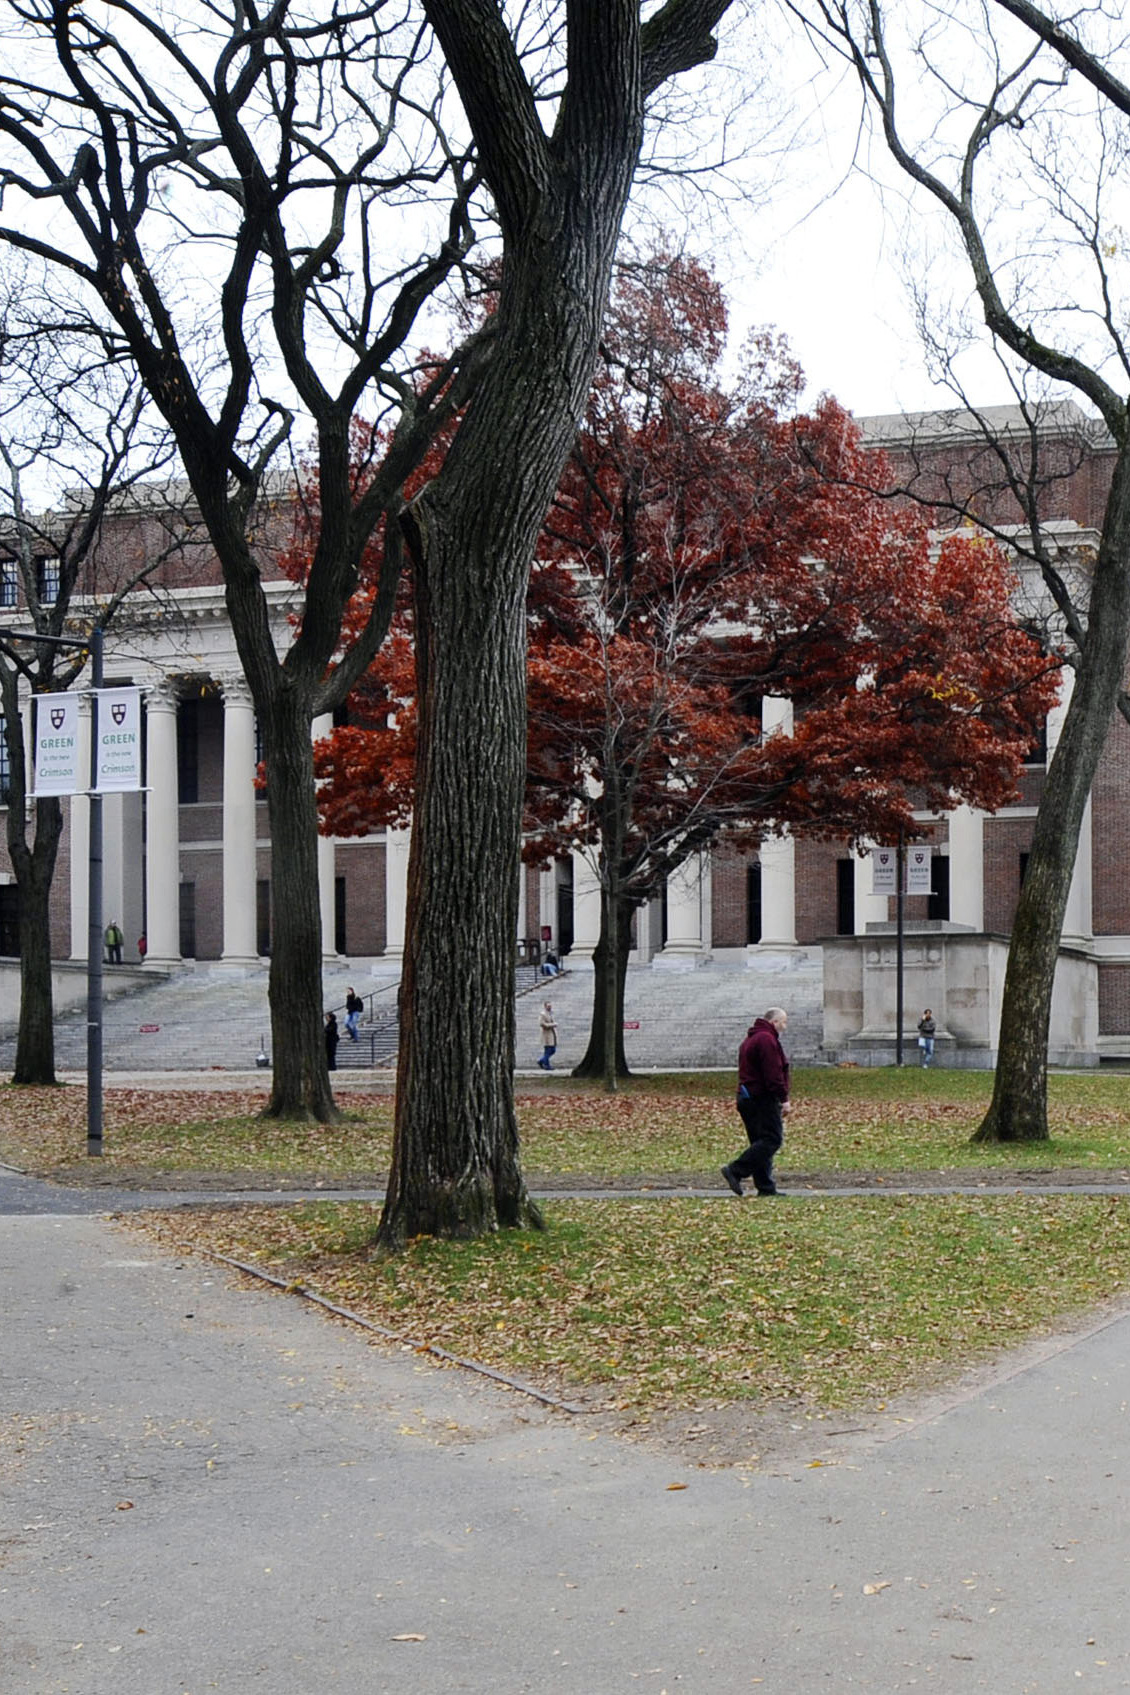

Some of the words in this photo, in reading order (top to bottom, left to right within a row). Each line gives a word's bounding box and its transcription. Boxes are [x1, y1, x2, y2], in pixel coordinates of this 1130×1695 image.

[40, 737, 74, 749] GREEN
[102, 733, 136, 745] GREEN
[39, 768, 73, 777] Crimson
[101, 764, 135, 774] Crimson
